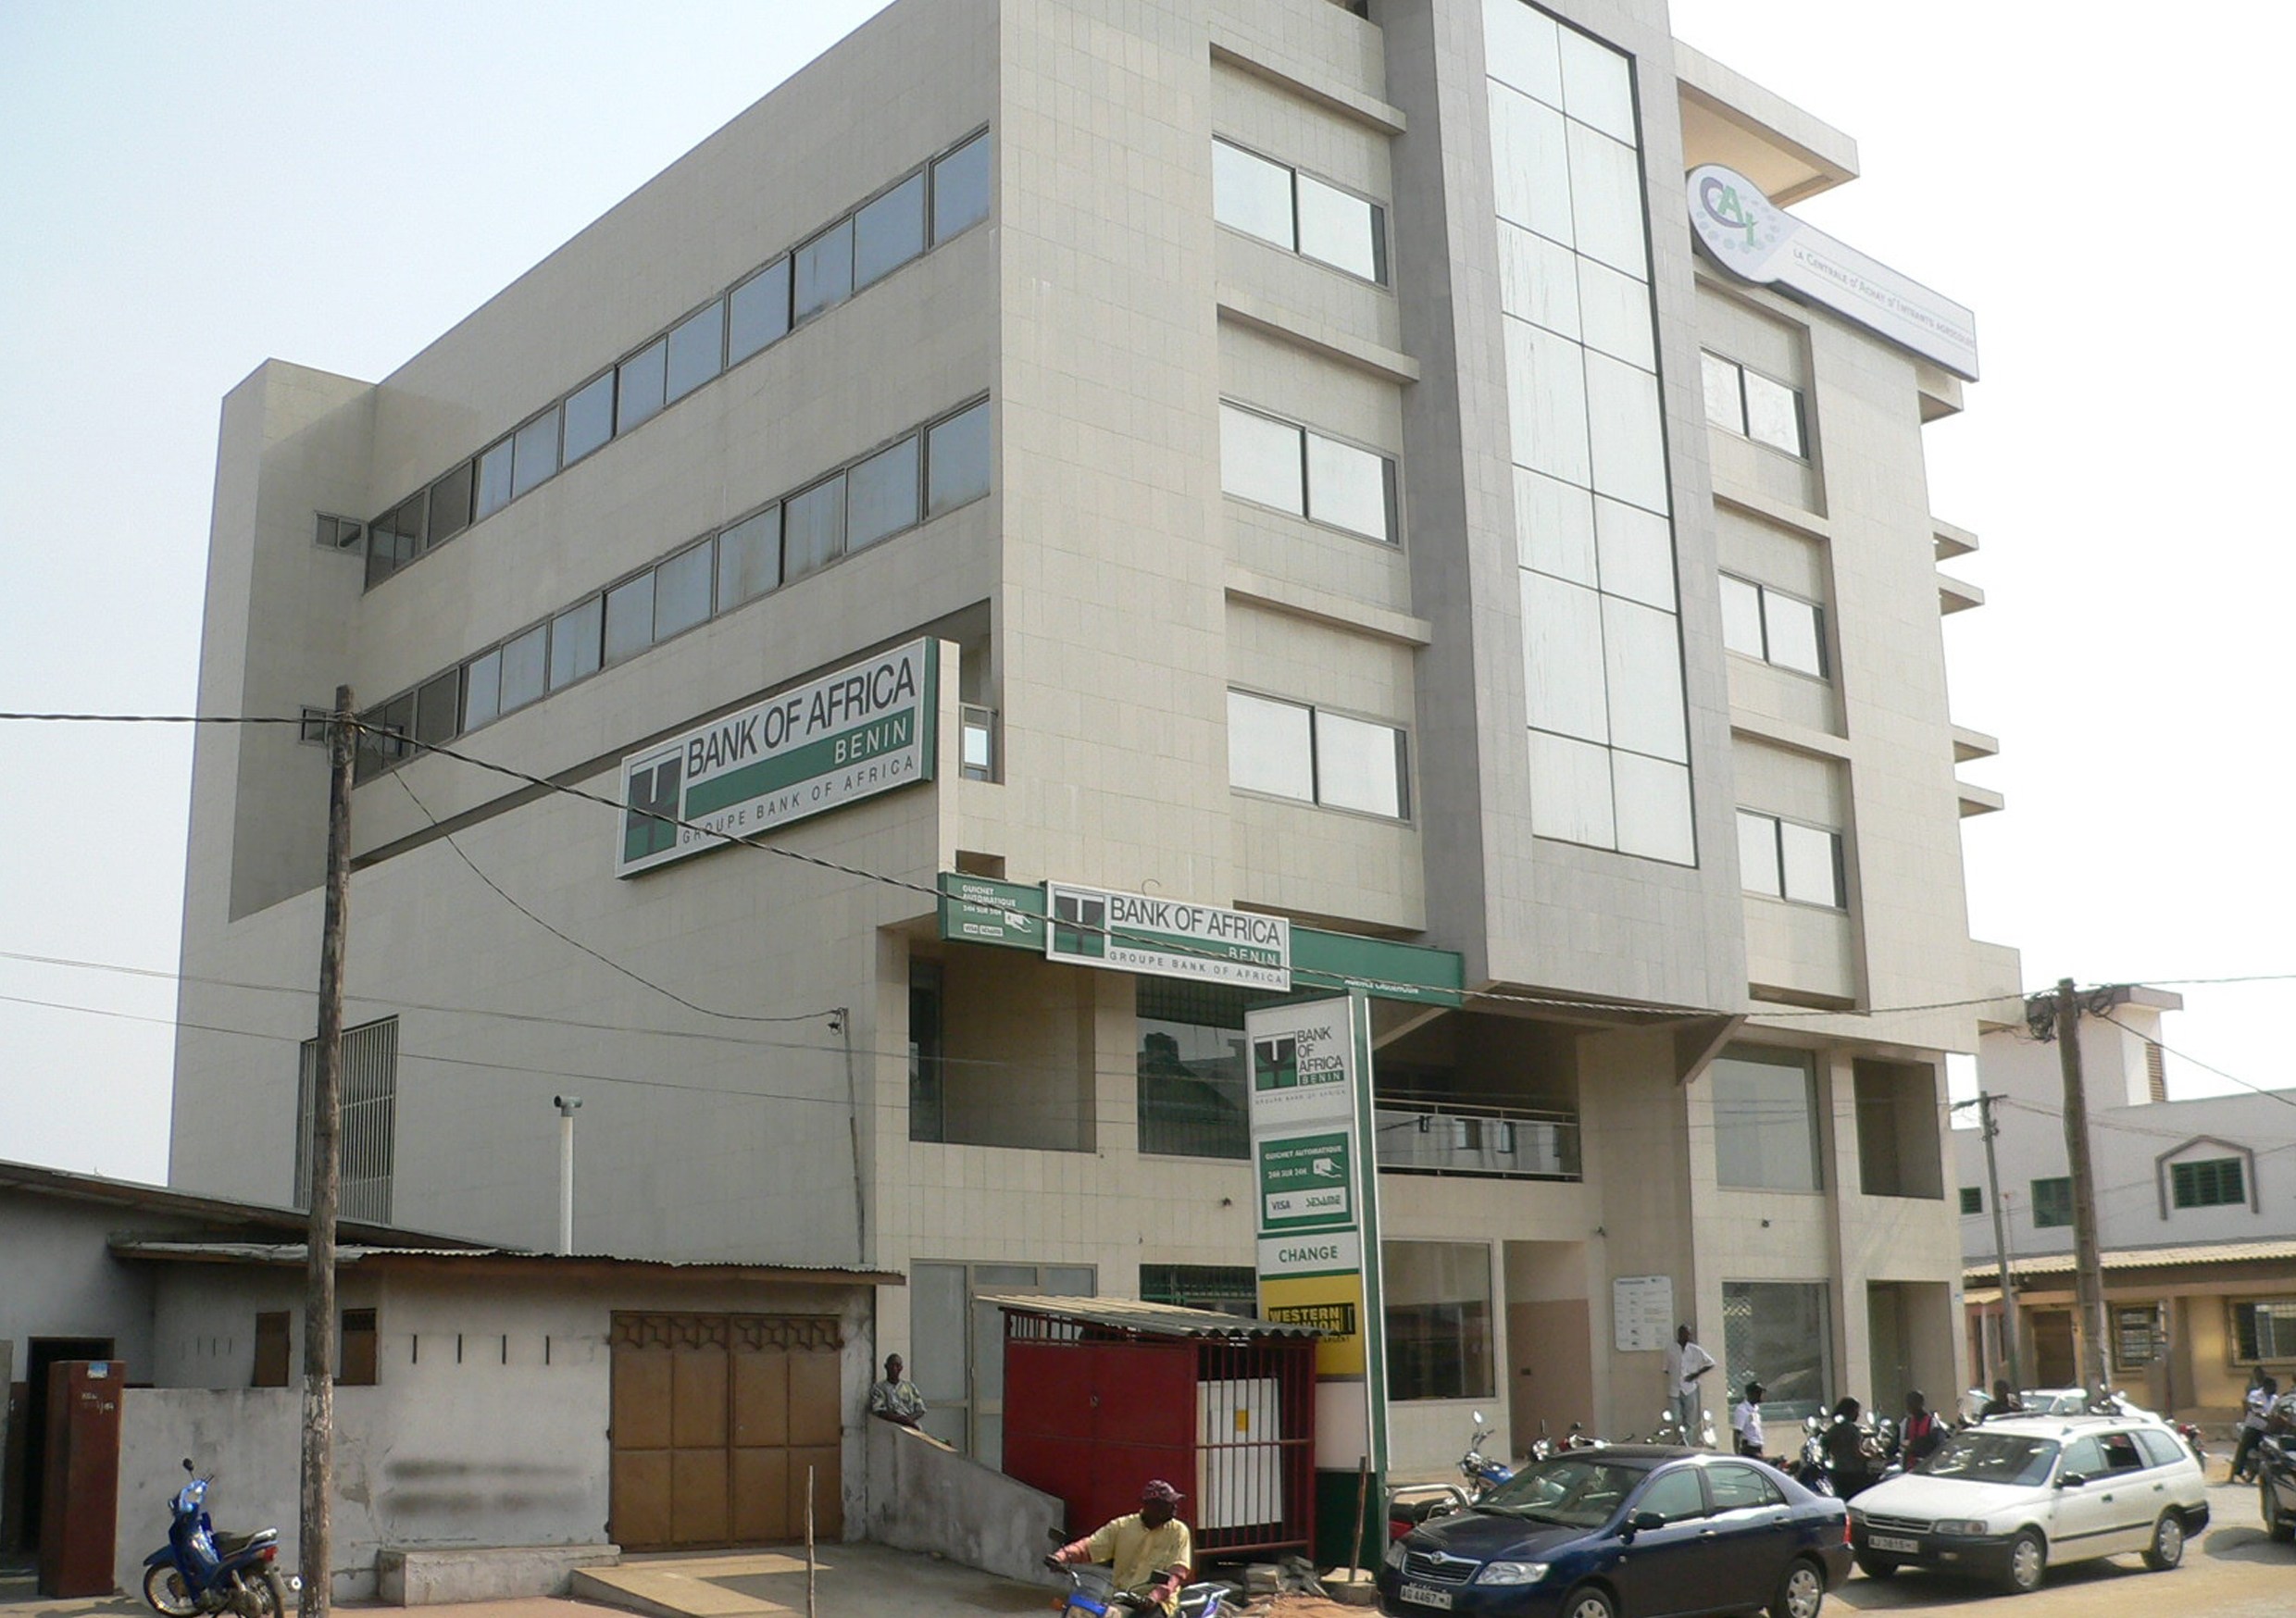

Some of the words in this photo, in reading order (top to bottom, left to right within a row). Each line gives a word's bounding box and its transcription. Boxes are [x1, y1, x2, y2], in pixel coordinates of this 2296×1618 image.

[687, 715, 759, 779] BANK
[764, 698, 802, 749] OF
[805, 657, 916, 734] AFRICA
[834, 716, 907, 765] BENIN
[683, 809, 745, 844] GROUPE
[756, 791, 801, 820] BANK
[812, 783, 833, 802] OF
[843, 755, 914, 790] AFRICA
[962, 884, 994, 895] GUICHET
[962, 893, 1017, 907] AUTOMATIQUE
[1110, 897, 1170, 928] BANK
[1175, 906, 1203, 932] OF
[1207, 913, 1281, 947] AFRICA
[1229, 946, 1278, 965] BENIN
[1109, 952, 1164, 966] GROUPE
[1172, 959, 1207, 973] BANK
[1214, 965, 1229, 976] OF
[1236, 968, 1283, 984] AFRICA
[1297, 1027, 1332, 1043] BANK
[1297, 1043, 1315, 1058] OF
[1298, 1055, 1343, 1073] AFRICA
[1302, 1073, 1341, 1085] BENIN
[1265, 1150, 1293, 1161] GUICHET
[1295, 1145, 1342, 1157] AUTOMATIQUE
[1281, 1168, 1293, 1177] SUR
[1271, 1200, 1291, 1211] VISA
[1279, 1245, 1339, 1263] CHANGE
[1269, 1307, 1340, 1323] WESTERN
